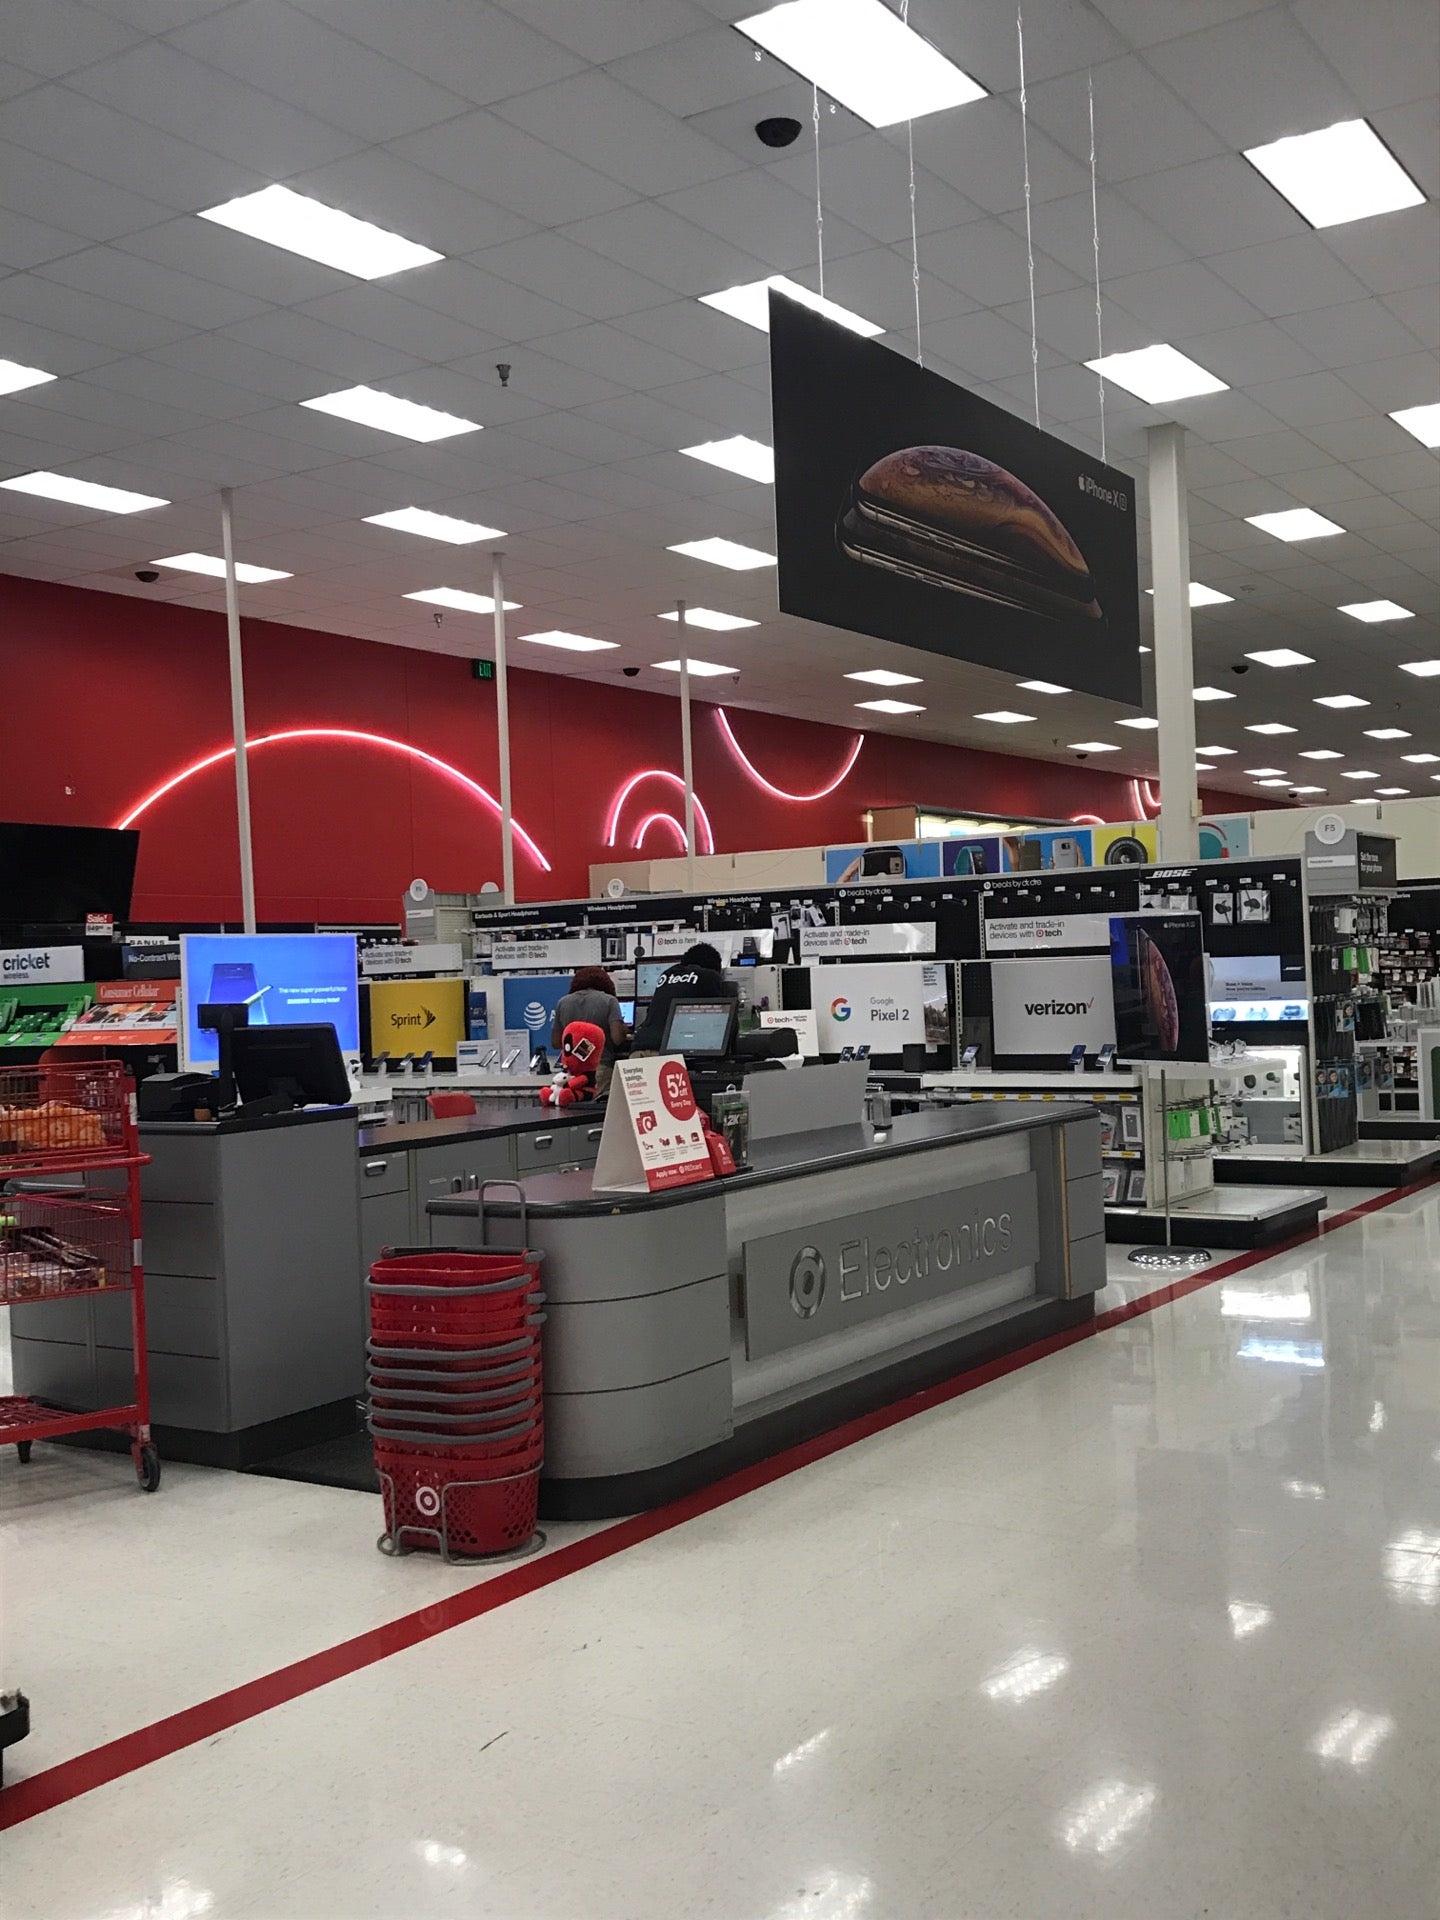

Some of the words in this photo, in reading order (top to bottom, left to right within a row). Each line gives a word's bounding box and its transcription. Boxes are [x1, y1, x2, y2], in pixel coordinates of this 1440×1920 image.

[1085, 475, 1112, 505] iPhone
[1324, 824, 1336, 832] F5
[1145, 868, 1198, 879] BOSE
[729, 895, 762, 904] Headphones
[87, 913, 108, 923] Sale!
[989, 922, 1018, 930] Activate
[1019, 921, 1034, 930] and
[1035, 920, 1065, 929] trade-in
[803, 930, 829, 938] Activate
[829, 929, 843, 937] and
[989, 930, 1018, 940] devices
[1019, 929, 1035, 938] with
[1045, 928, 1063, 937] tech
[803, 938, 829, 947] devices
[829, 937, 843, 946] with
[852, 937, 867, 945] tech
[495, 945, 516, 953] Activate
[3, 952, 50, 971] cricket
[128, 953, 167, 963] No-Contract
[3, 971, 30, 979] wireless
[667, 972, 699, 984] tech
[100, 986, 133, 998] Consumer
[133, 984, 160, 997] Cellular
[870, 996, 894, 1006] Google
[1024, 999, 1087, 1016] verizon
[870, 1008, 899, 1021] Pixel
[902, 1008, 910, 1021] 2
[391, 1013, 421, 1029] Sprint
[622, 1067, 644, 1075] Everyday
[666, 1073, 687, 1099] 5%
[680, 1088, 689, 1097] off
[670, 1099, 684, 1108] Every
[683, 1098, 692, 1107] Day
[655, 1170, 668, 1178] Apply
[839, 1207, 1013, 1301] Electronics
